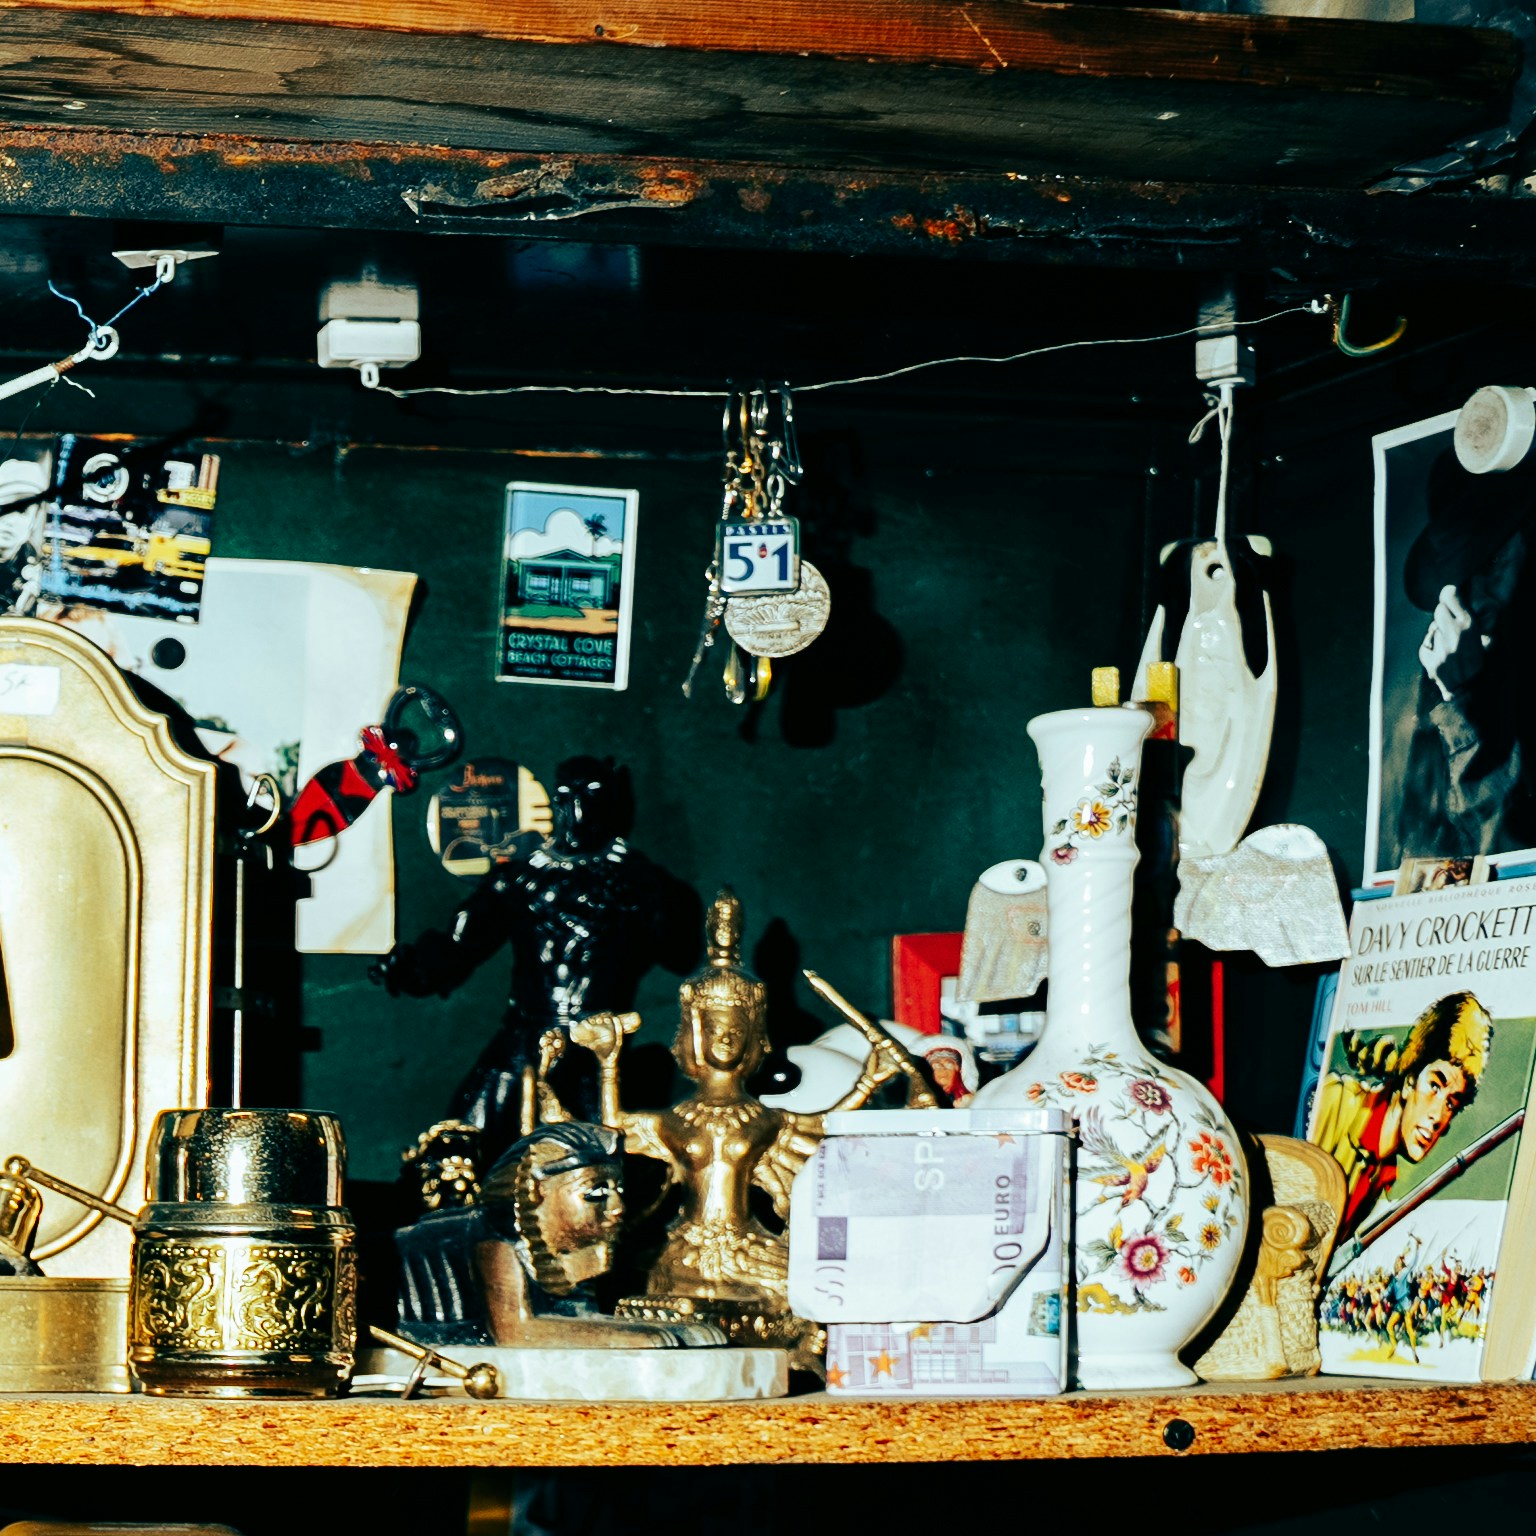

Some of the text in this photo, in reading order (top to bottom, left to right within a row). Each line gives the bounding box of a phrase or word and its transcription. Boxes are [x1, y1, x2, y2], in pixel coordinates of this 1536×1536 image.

[508, 632, 614, 656] CRYSTAL COVE
[508, 650, 614, 671] BEACH COTTAGES
[1358, 905, 1536, 956] DAVY CROCKETT
[1352, 946, 1531, 986] SUR LE SENTIER DE LA GUERRE
[1371, 999, 1392, 1014] HILL
[995, 1174, 1012, 1235] EURO
